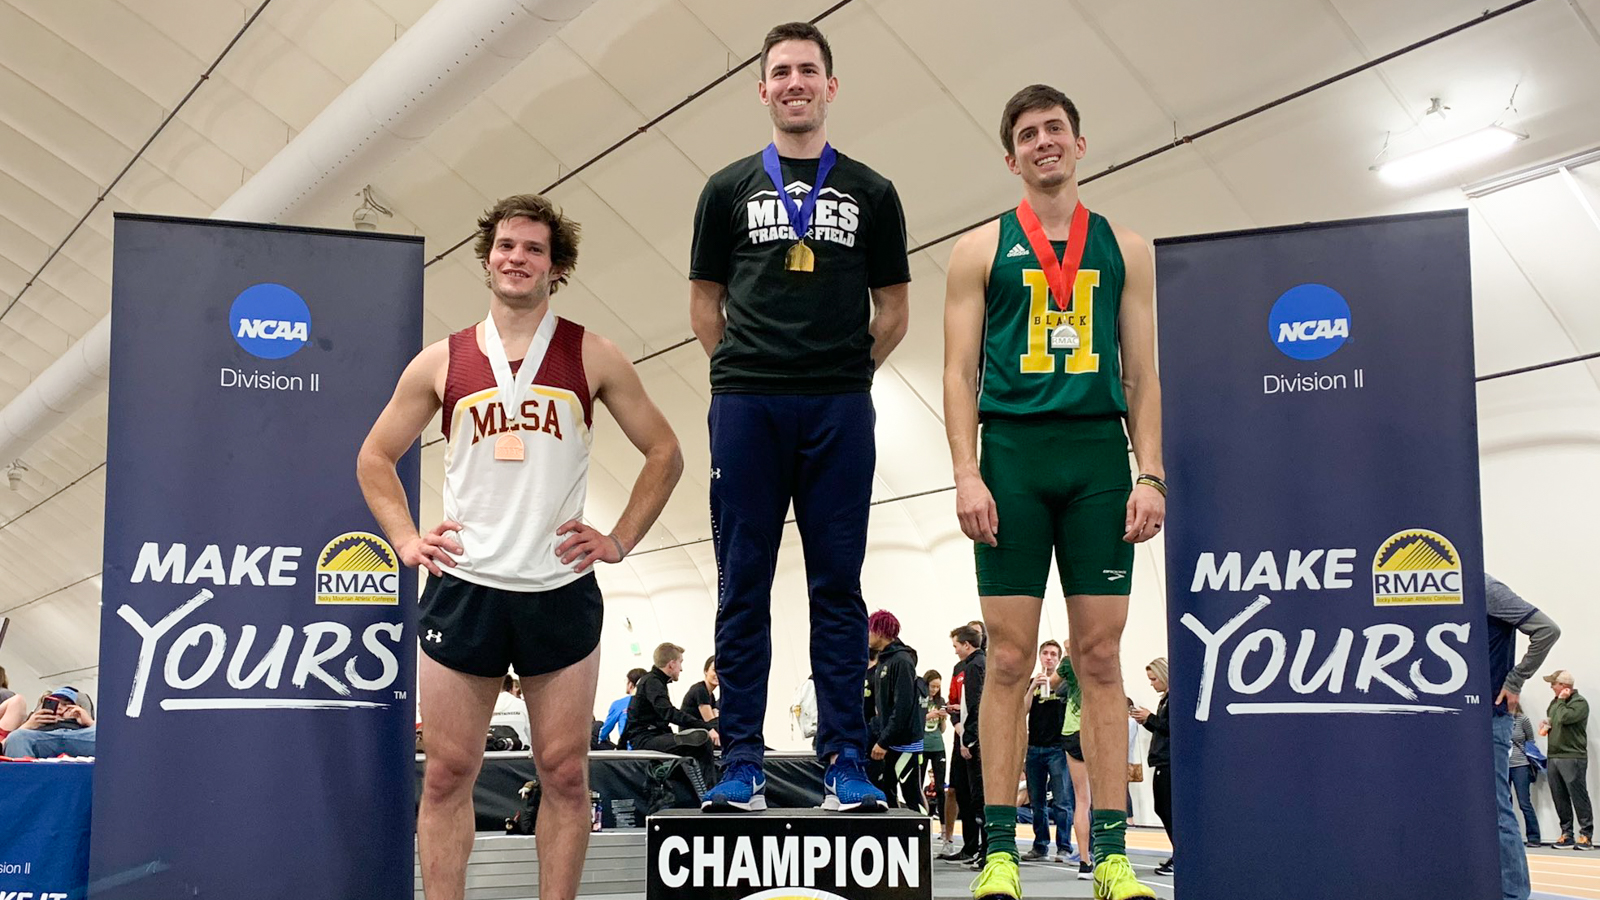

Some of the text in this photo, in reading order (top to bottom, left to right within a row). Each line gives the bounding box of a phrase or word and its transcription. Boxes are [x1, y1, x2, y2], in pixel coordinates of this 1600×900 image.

[747, 199, 860, 232] MIES
[815, 226, 856, 248] FIELD
[237, 318, 308, 342] NCAA
[1020, 269, 1100, 373] H
[1034, 315, 1088, 327] BLACK
[1277, 318, 1349, 343] NCAA
[220, 367, 320, 392] Division II
[1263, 368, 1364, 394] Division II
[130, 542, 302, 586] MAKE
[1190, 549, 1356, 592] MAKE
[318, 573, 396, 593] RMAC
[1375, 572, 1459, 594] RMAC
[116, 588, 407, 718] YOURS TM
[1180, 595, 1480, 721] YOURS TM
[658, 834, 920, 889] CHAMPION
